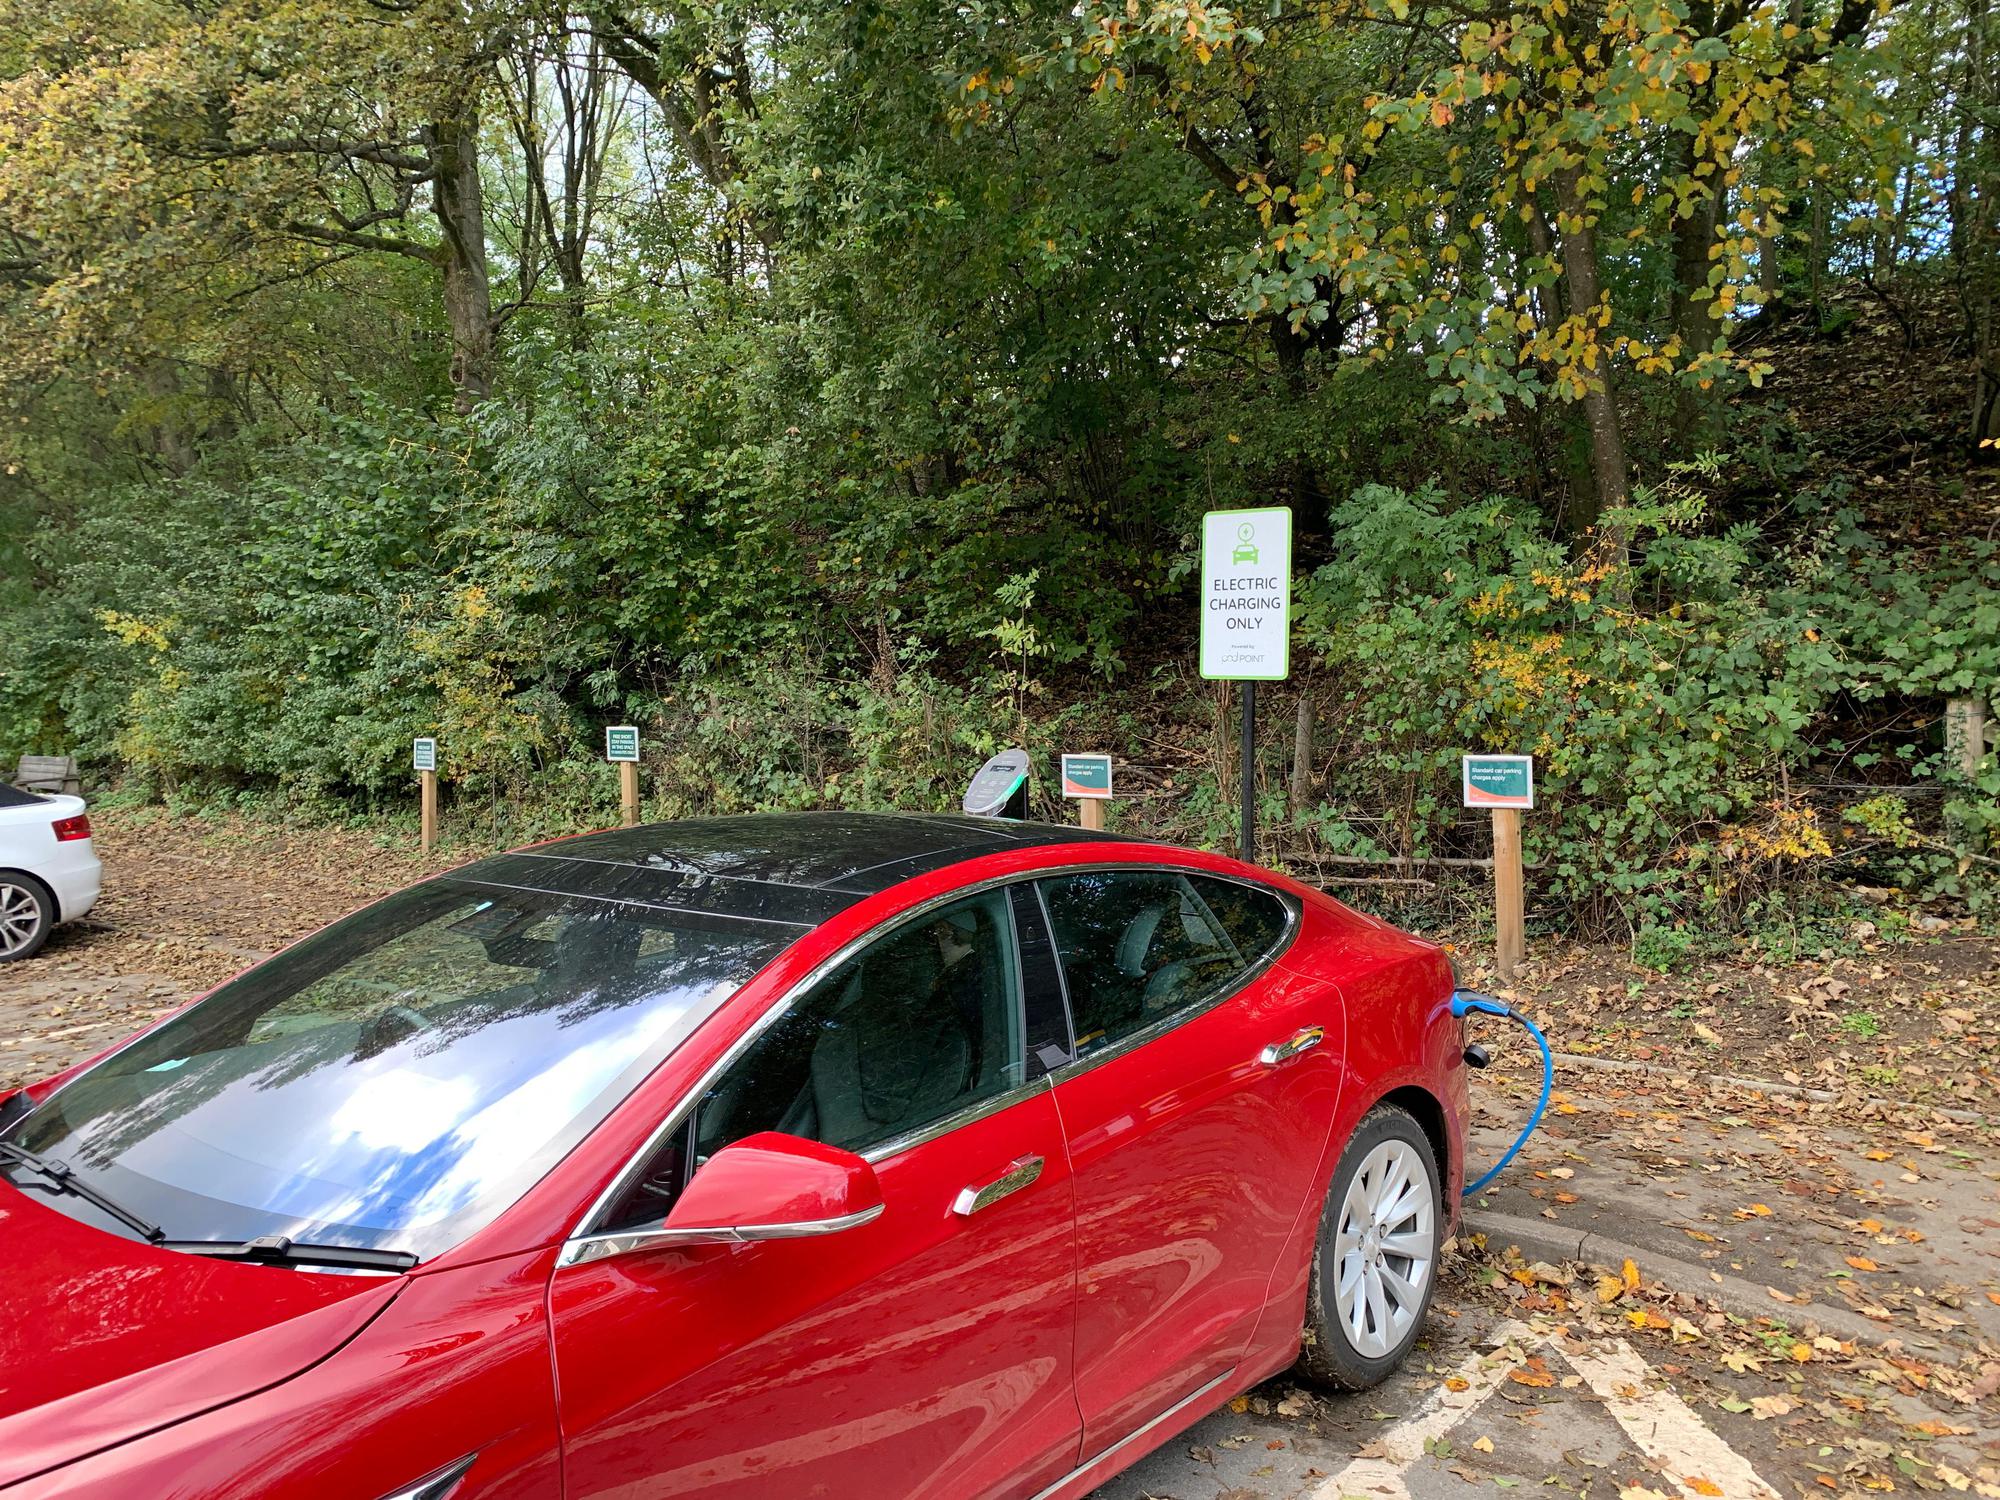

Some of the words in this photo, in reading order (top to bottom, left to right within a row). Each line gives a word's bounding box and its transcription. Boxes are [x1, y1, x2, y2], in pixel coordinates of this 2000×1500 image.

[1214, 577, 1278, 591] ELECTRIC
[1210, 597, 1281, 611] CHARGING
[1226, 617, 1263, 630] ONLY
